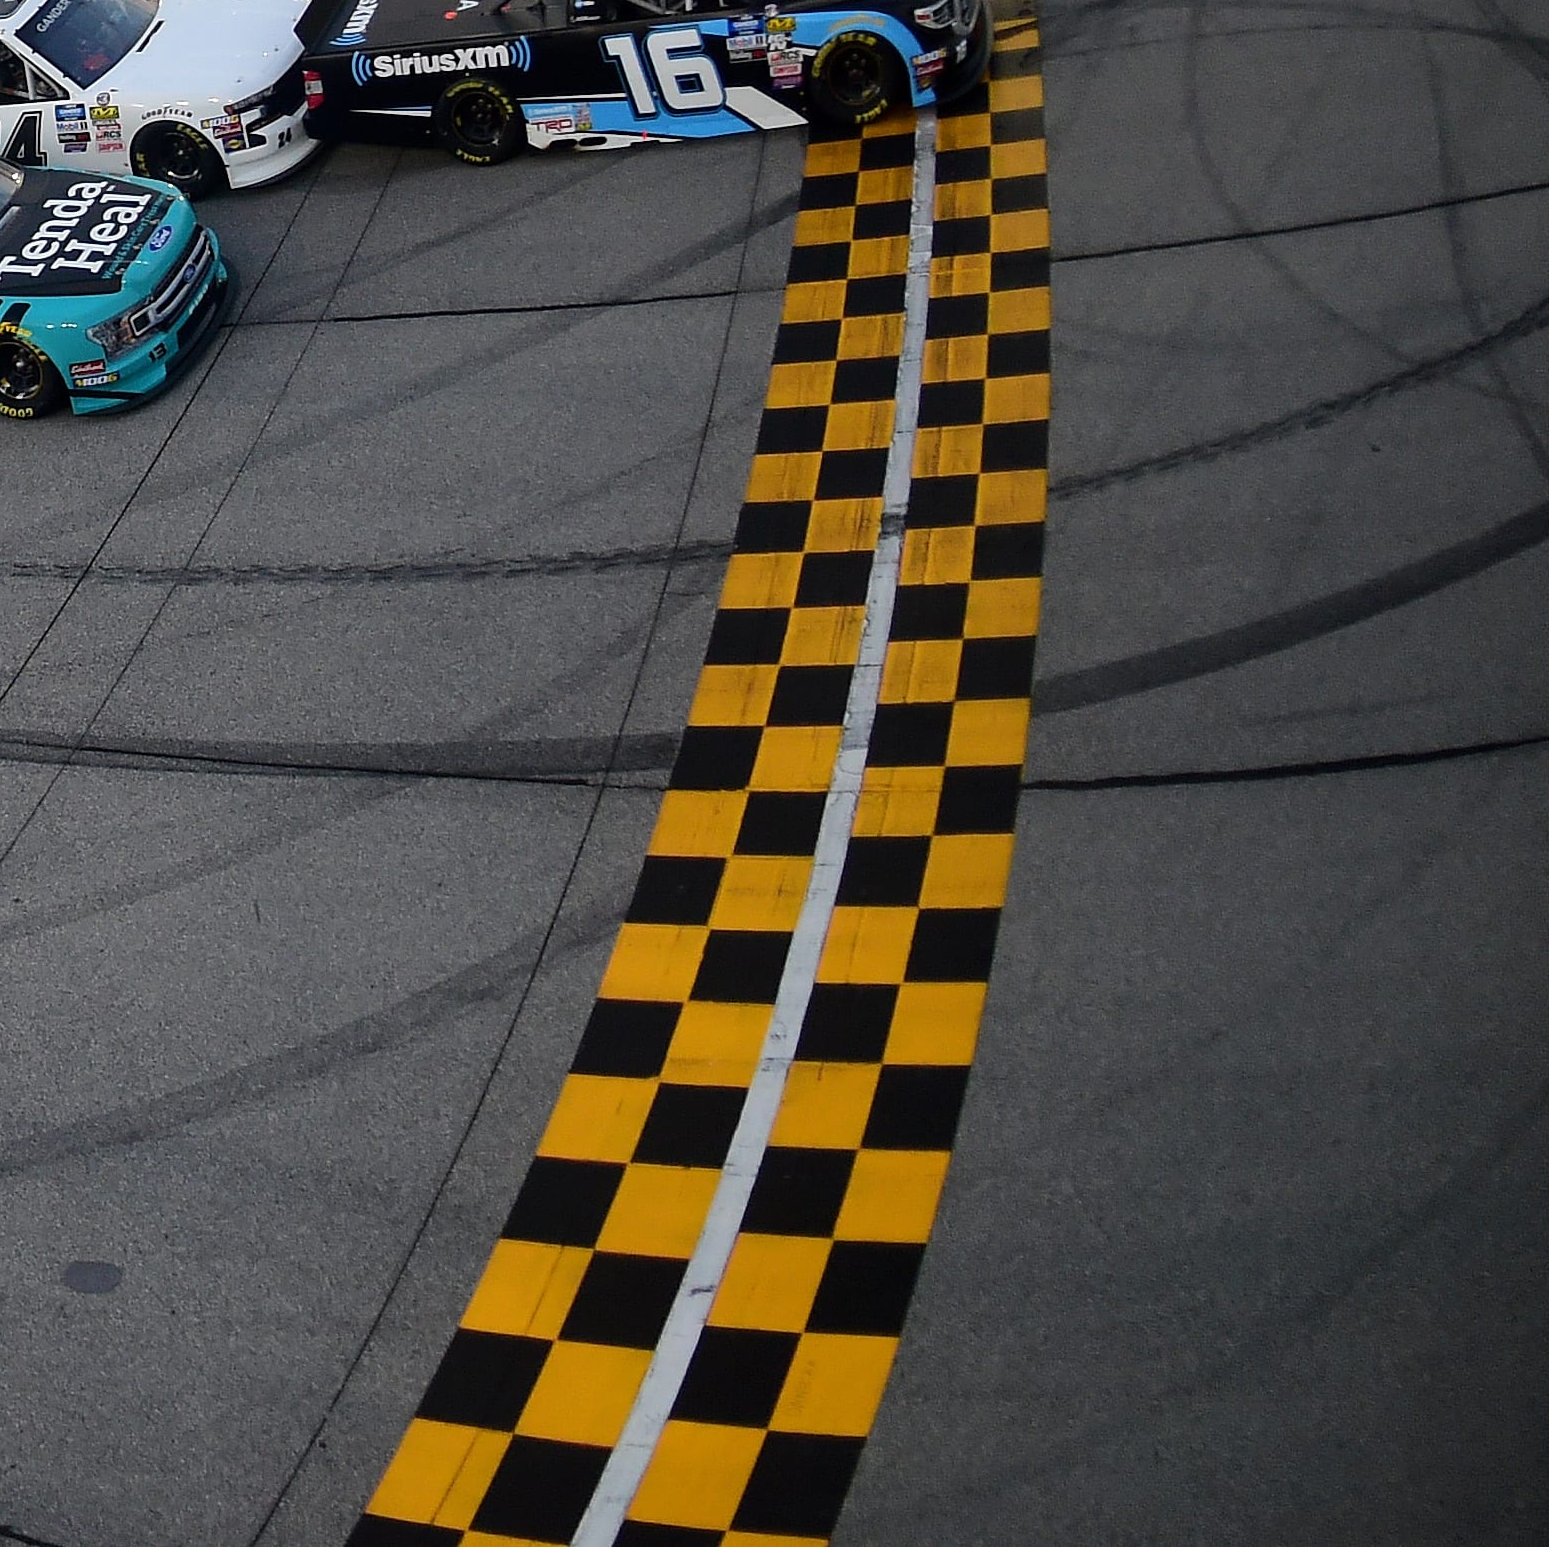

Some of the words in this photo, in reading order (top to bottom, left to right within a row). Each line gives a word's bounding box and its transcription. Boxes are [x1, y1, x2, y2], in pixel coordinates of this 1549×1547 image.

[603, 28, 725, 116] 16
[141, 106, 194, 121] GOODYEAR
[530, 118, 574, 134] TRD
[175, 124, 209, 150] EAGLE
[51, 192, 152, 274] Heal
[75, 374, 117, 388] MOOG
